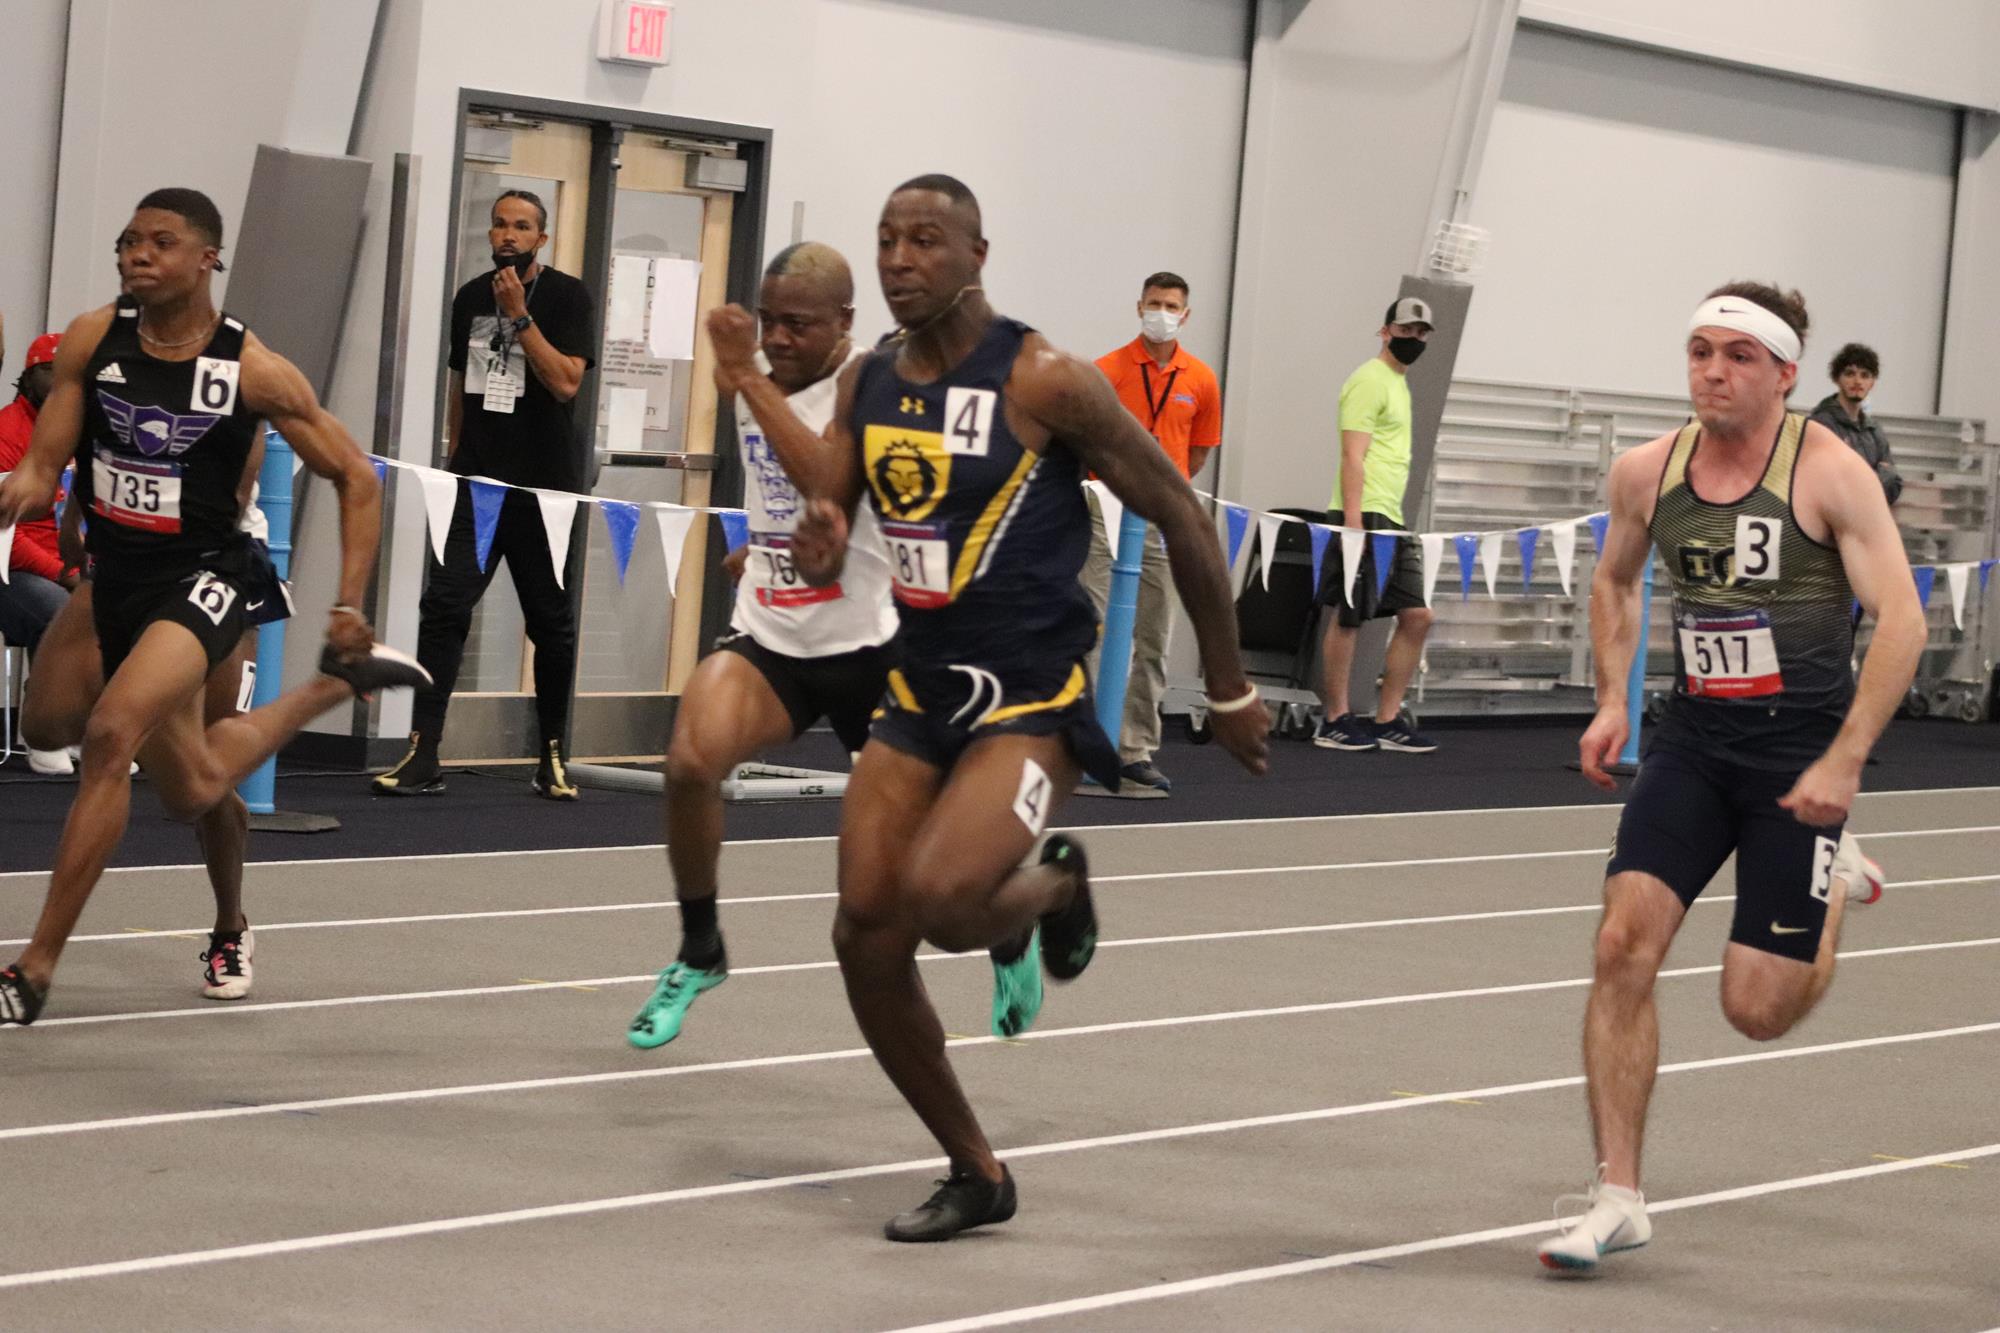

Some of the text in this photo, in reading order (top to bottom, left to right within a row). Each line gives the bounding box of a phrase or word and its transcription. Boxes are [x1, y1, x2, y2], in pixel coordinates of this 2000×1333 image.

[628, 5, 668, 58] EXIT
[200, 370, 230, 409] 6
[952, 394, 980, 450] 4
[107, 469, 160, 513] 735
[1745, 521, 1770, 576] 3
[1693, 635, 1749, 675] 517
[1024, 777, 1044, 824] 4
